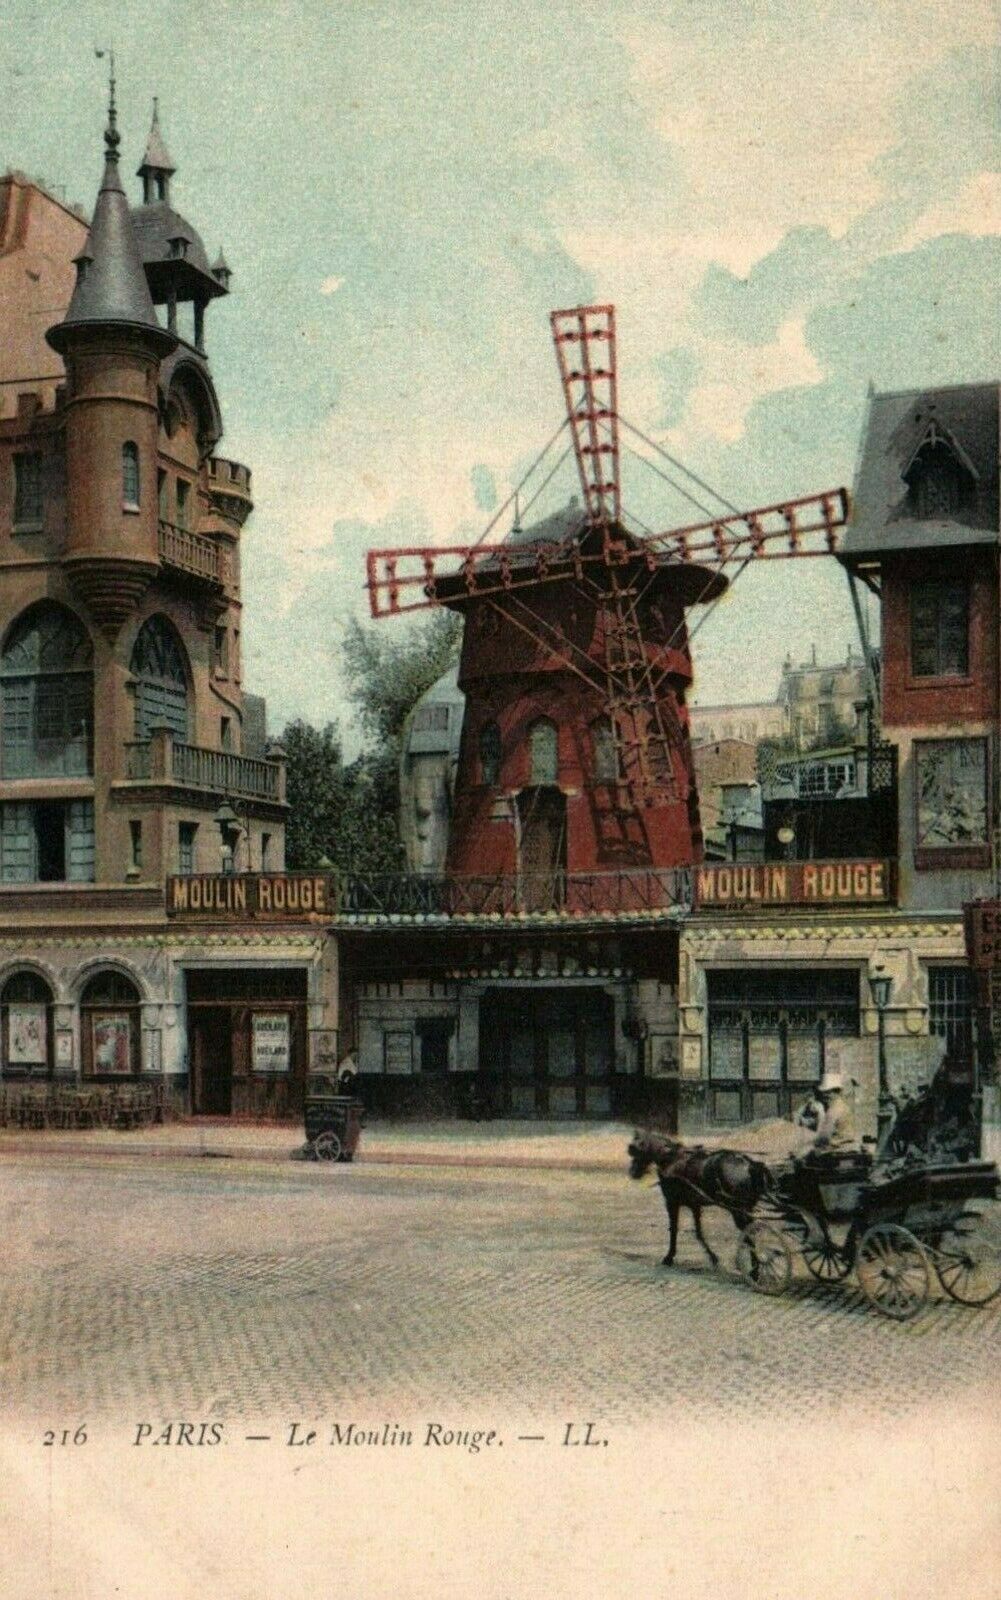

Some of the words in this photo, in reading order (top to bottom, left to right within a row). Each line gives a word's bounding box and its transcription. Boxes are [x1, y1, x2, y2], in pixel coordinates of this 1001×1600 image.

[173, 878, 247, 909] MOULIN
[259, 878, 326, 909] ROUGE
[696, 866, 787, 899] MOULIN
[803, 863, 884, 896] ROUGE
